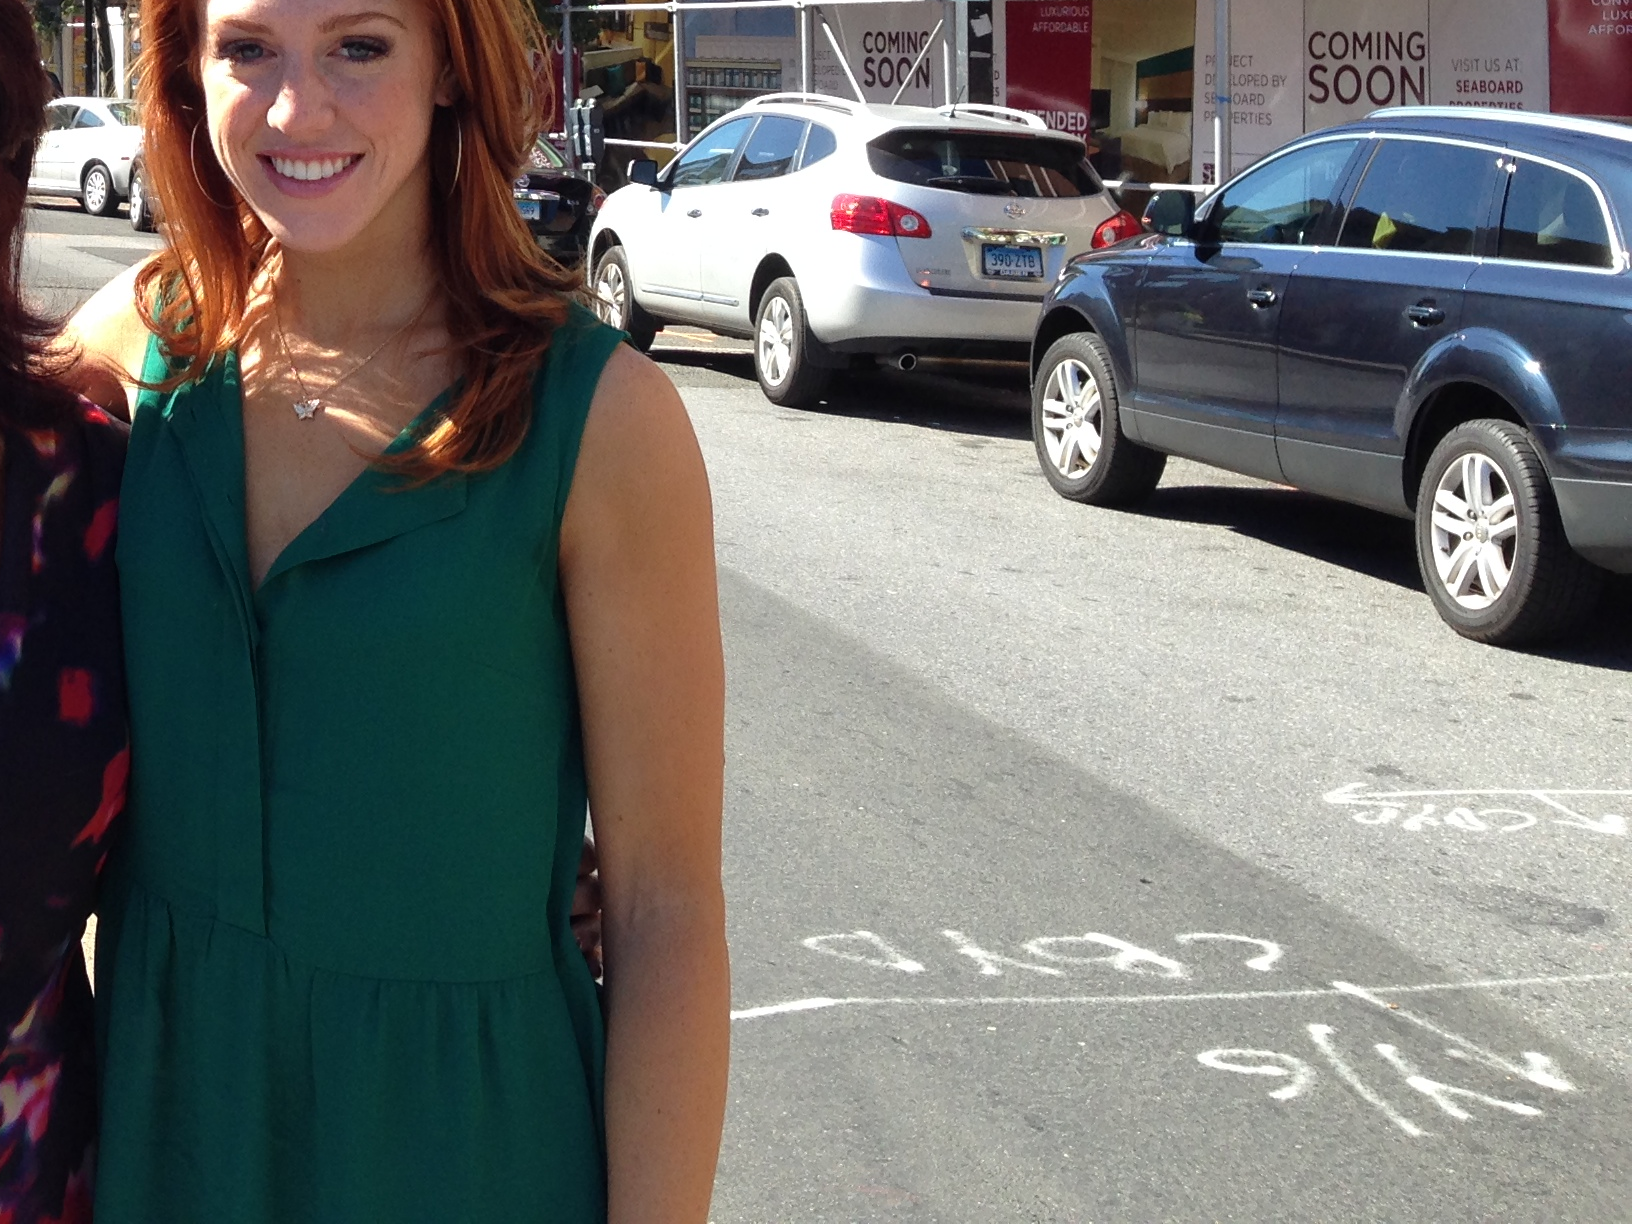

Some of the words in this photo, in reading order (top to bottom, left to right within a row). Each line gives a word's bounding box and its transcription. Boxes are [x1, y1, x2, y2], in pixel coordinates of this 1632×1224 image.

[1041, 6, 1090, 18] LUXURIOUS
[1032, 21, 1089, 34] AFFORDABLE
[862, 31, 931, 55] COMING
[1308, 31, 1426, 62] COMING
[863, 56, 931, 89] SOON
[1451, 58, 1480, 73] VISIT
[1484, 58, 1500, 73] US
[1271, 74, 1287, 88] BY
[1308, 64, 1426, 107] SOON
[1456, 80, 1524, 94] SEABOARD
